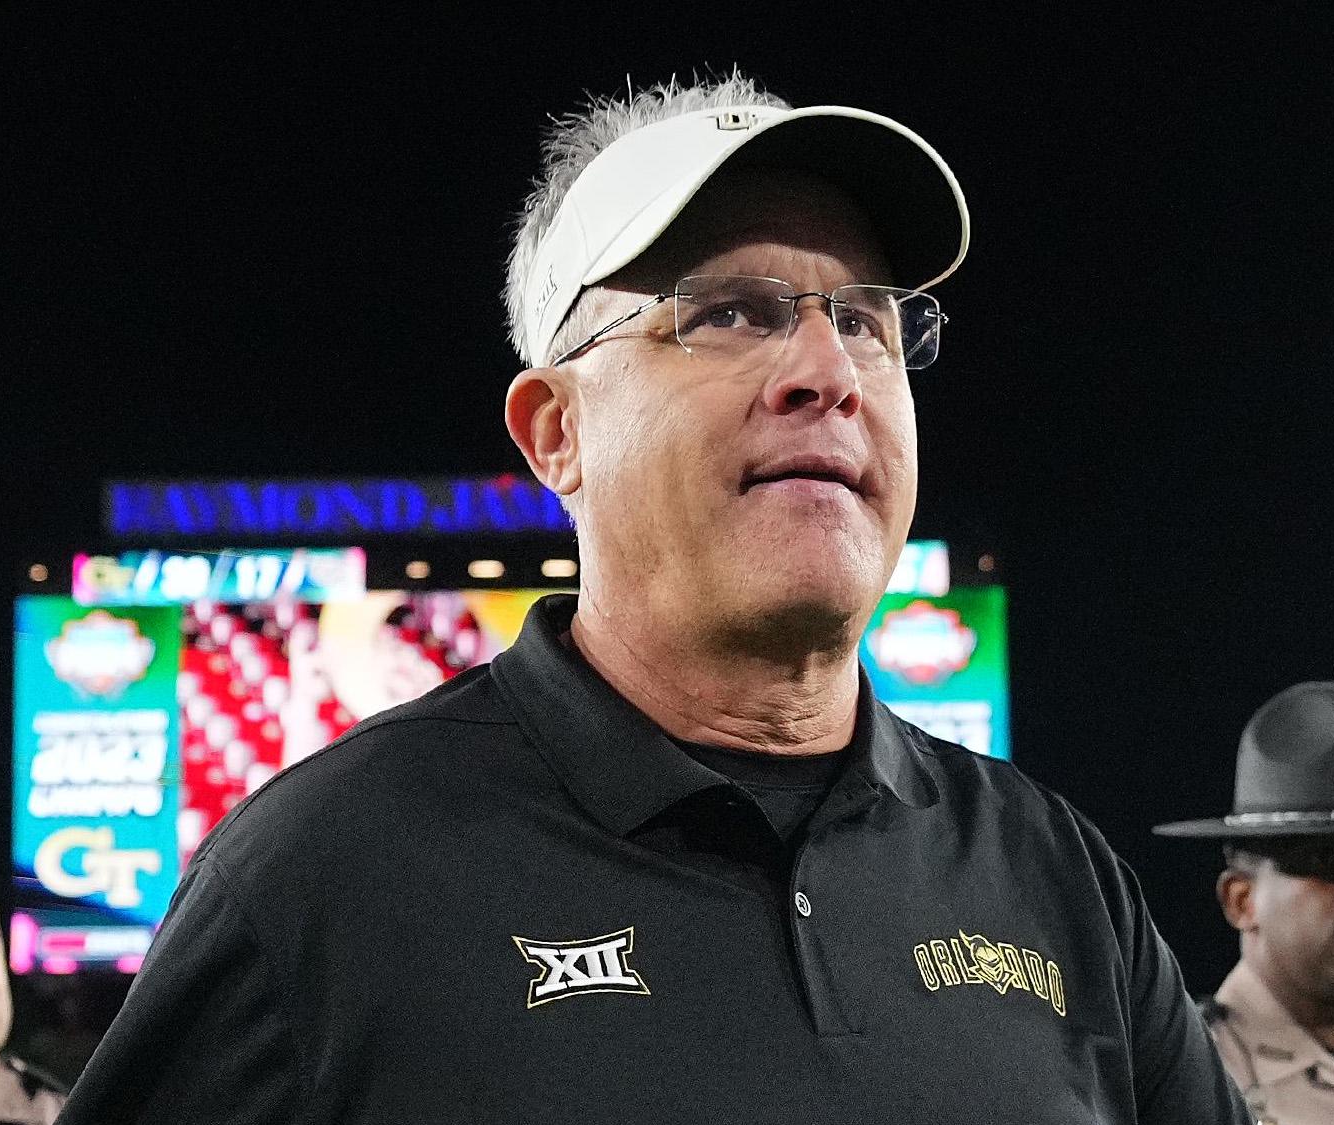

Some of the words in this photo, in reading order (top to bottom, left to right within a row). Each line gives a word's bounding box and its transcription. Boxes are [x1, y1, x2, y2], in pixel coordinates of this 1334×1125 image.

[111, 482, 430, 537] RAYMOND
[434, 479, 575, 535] JAM
[525, 937, 639, 997] XII
[913, 936, 1067, 1018] ORLNDO
